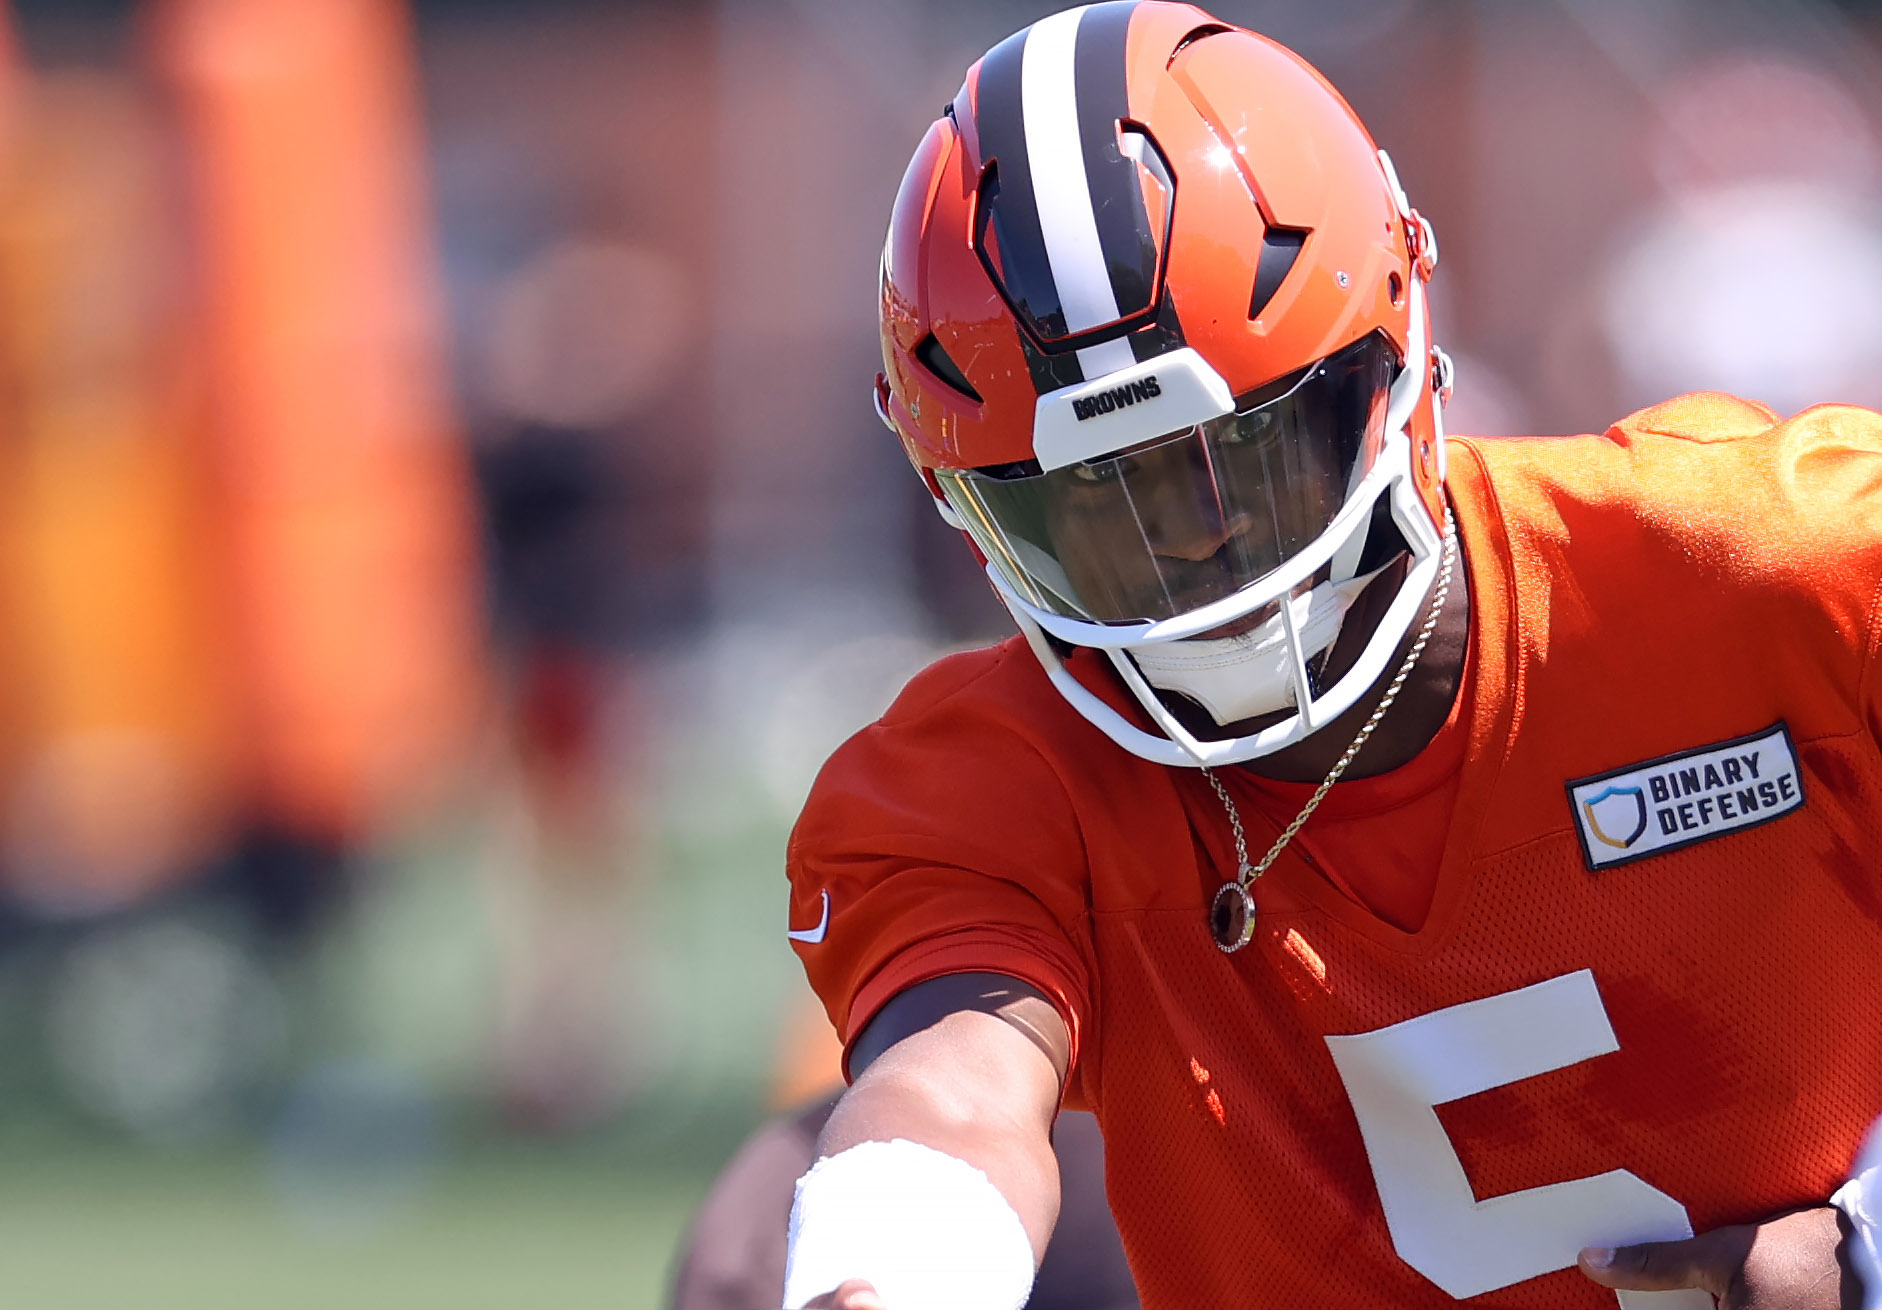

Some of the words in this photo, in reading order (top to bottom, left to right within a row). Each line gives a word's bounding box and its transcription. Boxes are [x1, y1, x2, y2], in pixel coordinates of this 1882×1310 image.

[1072, 375, 1161, 421] BROWNS
[1648, 752, 1760, 803] BINARY
[1656, 773, 1796, 835] DEFENSE
